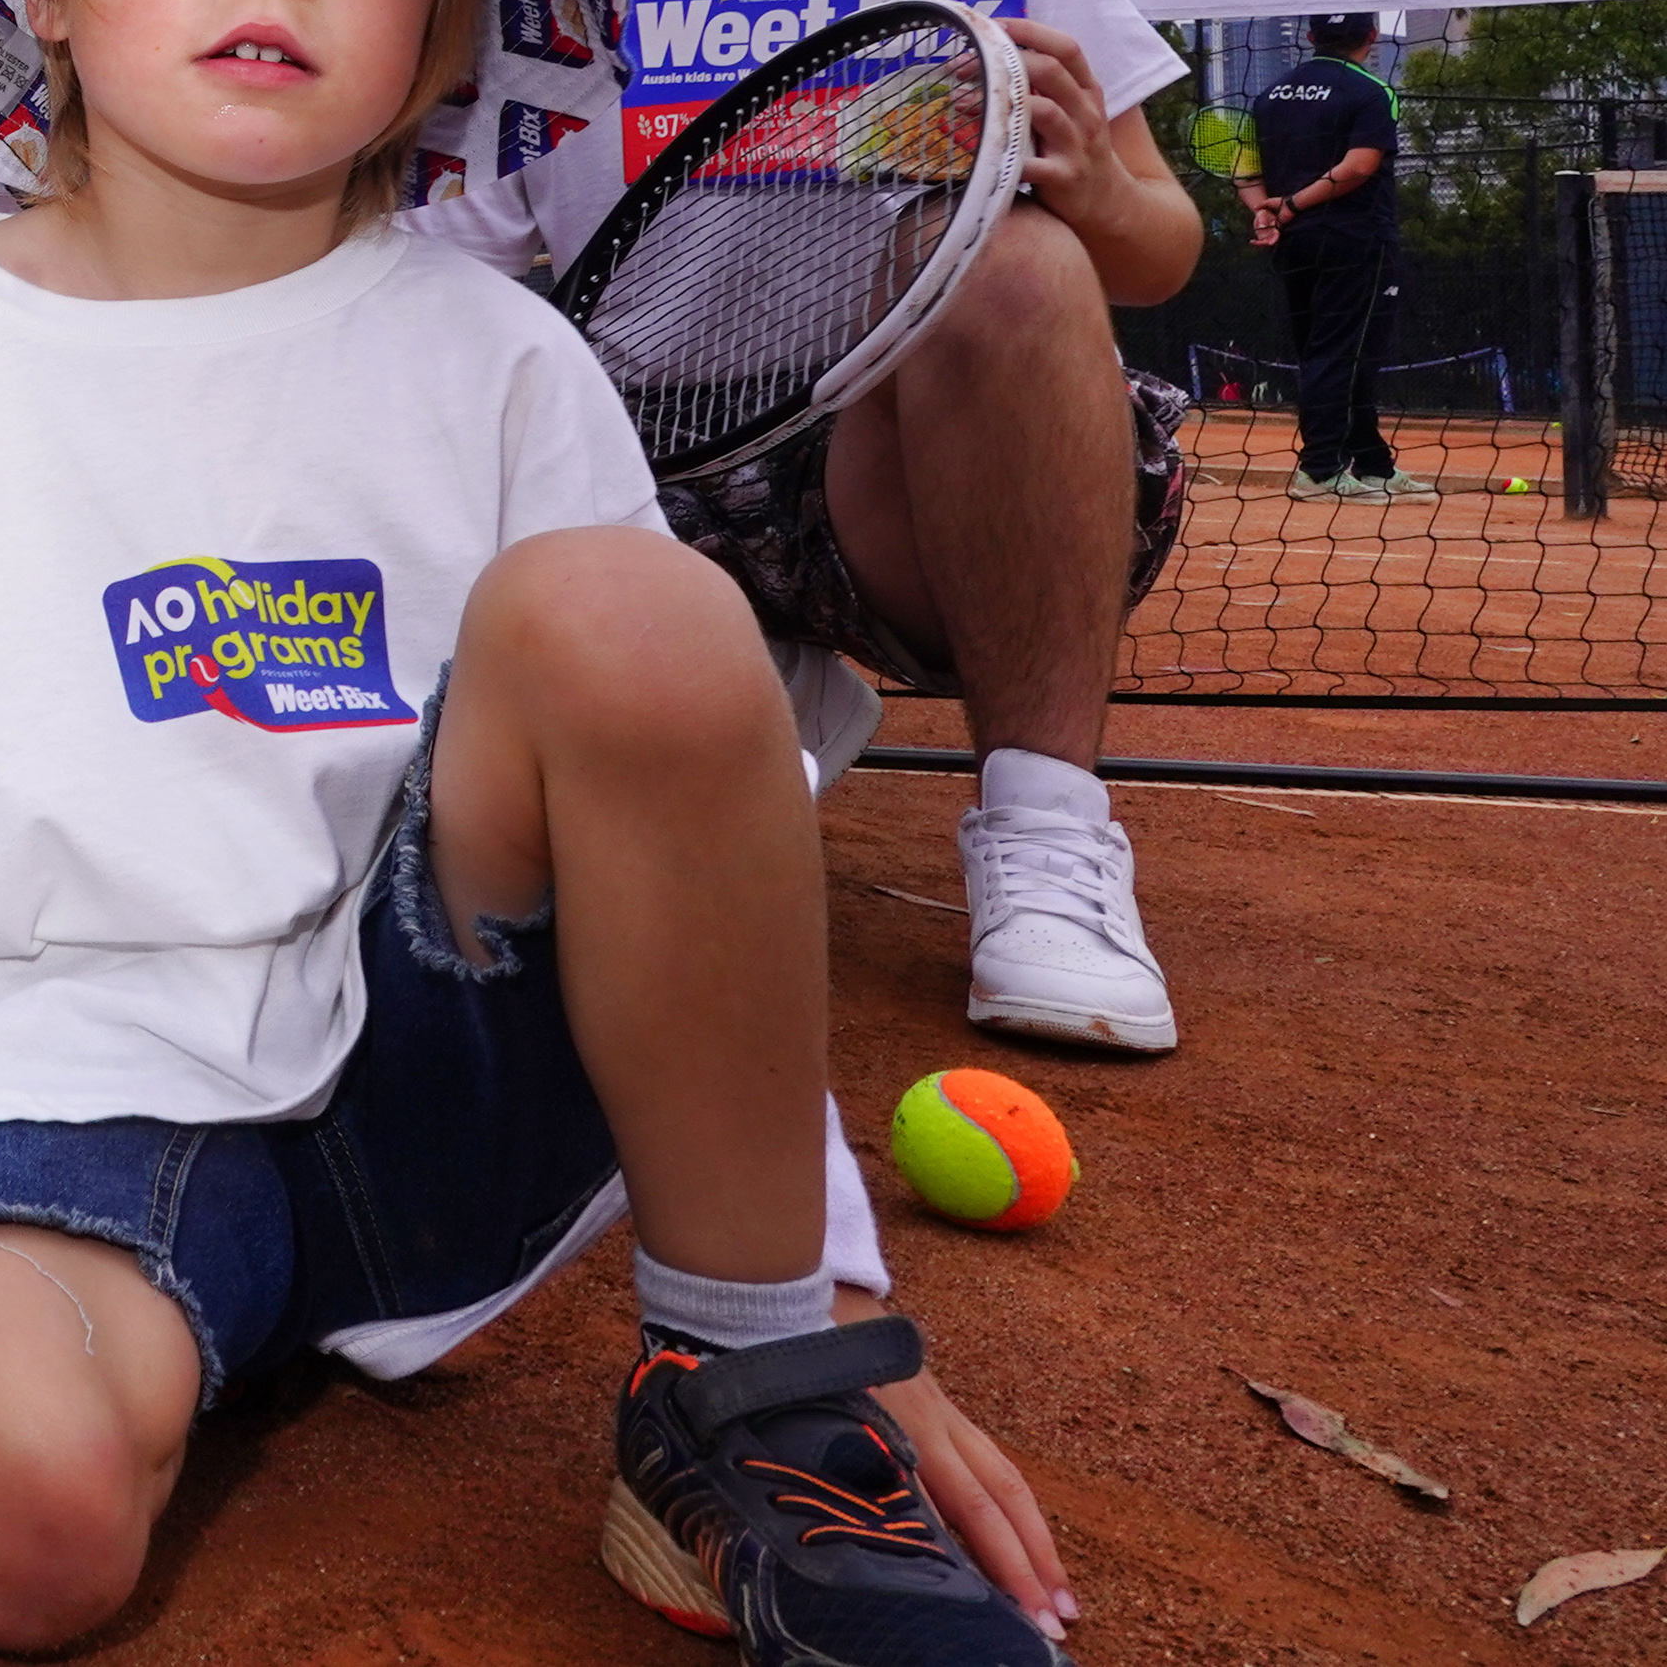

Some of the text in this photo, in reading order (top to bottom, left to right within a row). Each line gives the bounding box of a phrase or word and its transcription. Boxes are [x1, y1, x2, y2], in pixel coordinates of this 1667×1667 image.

[641, 73, 684, 85] Aussie
[684, 72, 712, 83] kids
[713, 72, 736, 83] are
[1268, 85, 1332, 101] COACH
[265, 683, 391, 714] Weet-Bix
